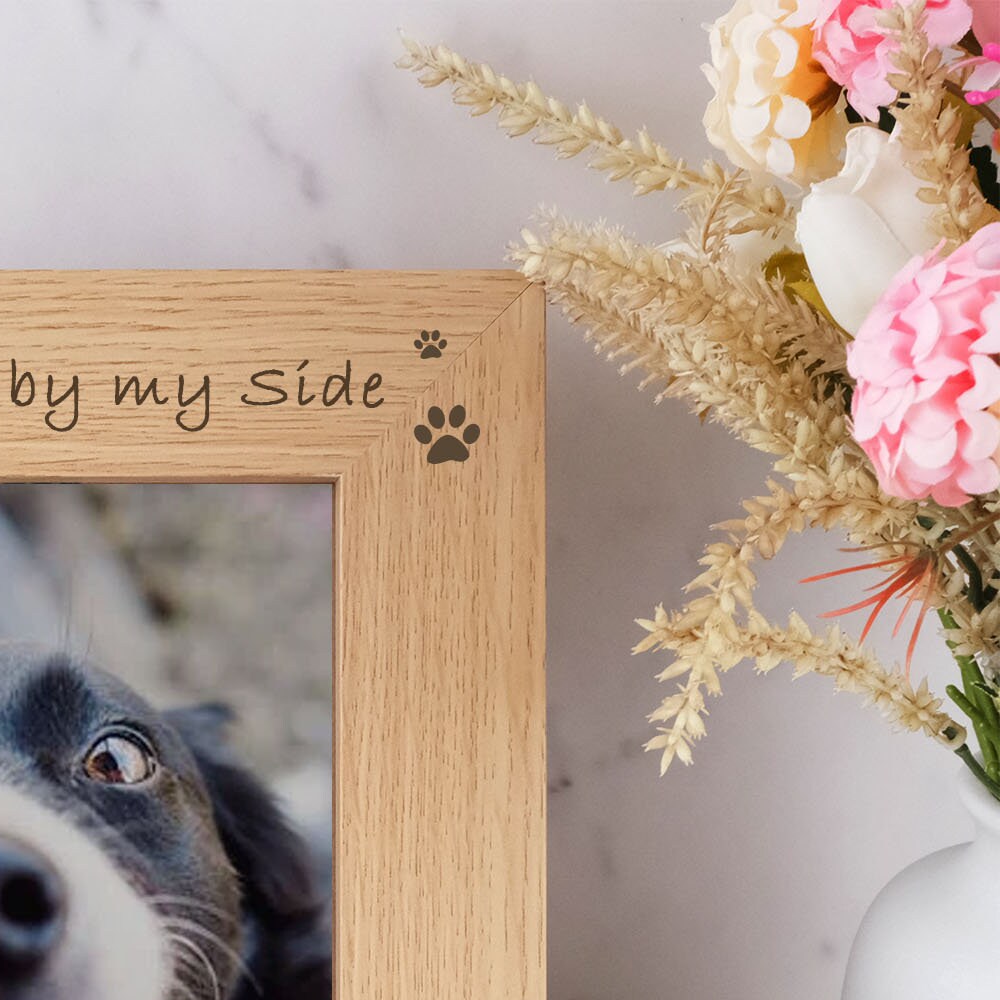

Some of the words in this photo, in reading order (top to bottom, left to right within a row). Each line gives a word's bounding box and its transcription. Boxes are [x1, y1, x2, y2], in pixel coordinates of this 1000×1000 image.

[10, 358, 80, 432] by
[114, 374, 211, 432] my
[240, 359, 385, 408] Side
